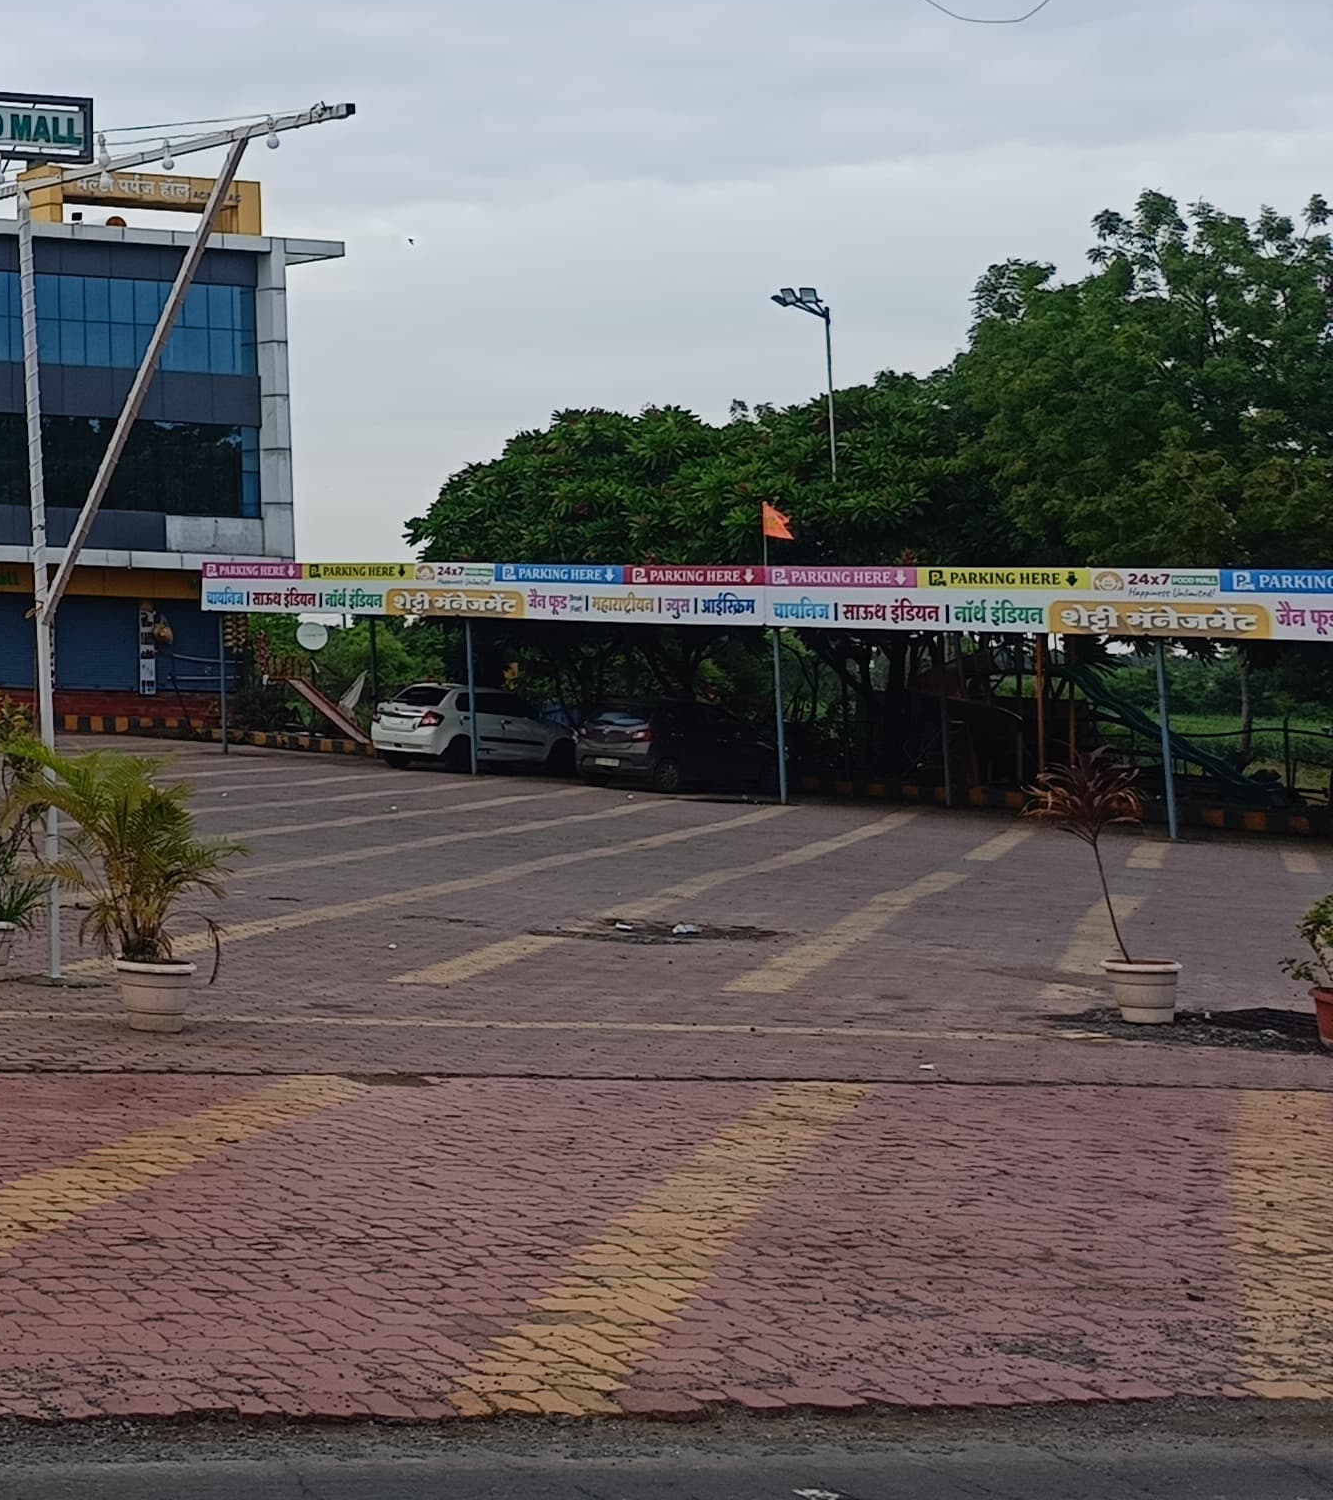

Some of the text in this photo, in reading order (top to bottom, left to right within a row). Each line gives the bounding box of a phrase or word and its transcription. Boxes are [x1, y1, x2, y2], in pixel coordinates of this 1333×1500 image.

[10, 113, 82, 145] MALL
[117, 174, 155, 194] पर्पज
[159, 178, 191, 197] हॉल
[219, 566, 285, 577] PARKING HERE
[323, 566, 395, 577] PARKING HERE
[437, 566, 464, 577] 24x7
[518, 567, 602, 581] PARKING HERE
[650, 570, 740, 582] PARKING HERE
[791, 570, 891, 584] PARKING HERE
[950, 572, 1061, 585] PARKING HERE
[1128, 573, 1170, 586] 24x7
[283, 587, 316, 608] इंडियन
[325, 587, 383, 609] नॉर्थ इंडियन
[527, 588, 546, 608] जैन
[548, 593, 567, 615] फूड
[664, 596, 690, 619] ज्युस
[773, 596, 830, 619] चायनिज
[842, 598, 940, 623] साऊथ इंडियन
[954, 599, 1044, 626] नॉर्थ इंडियन
[1061, 604, 1119, 633] शेट्टी
[1275, 601, 1305, 626] जैन
